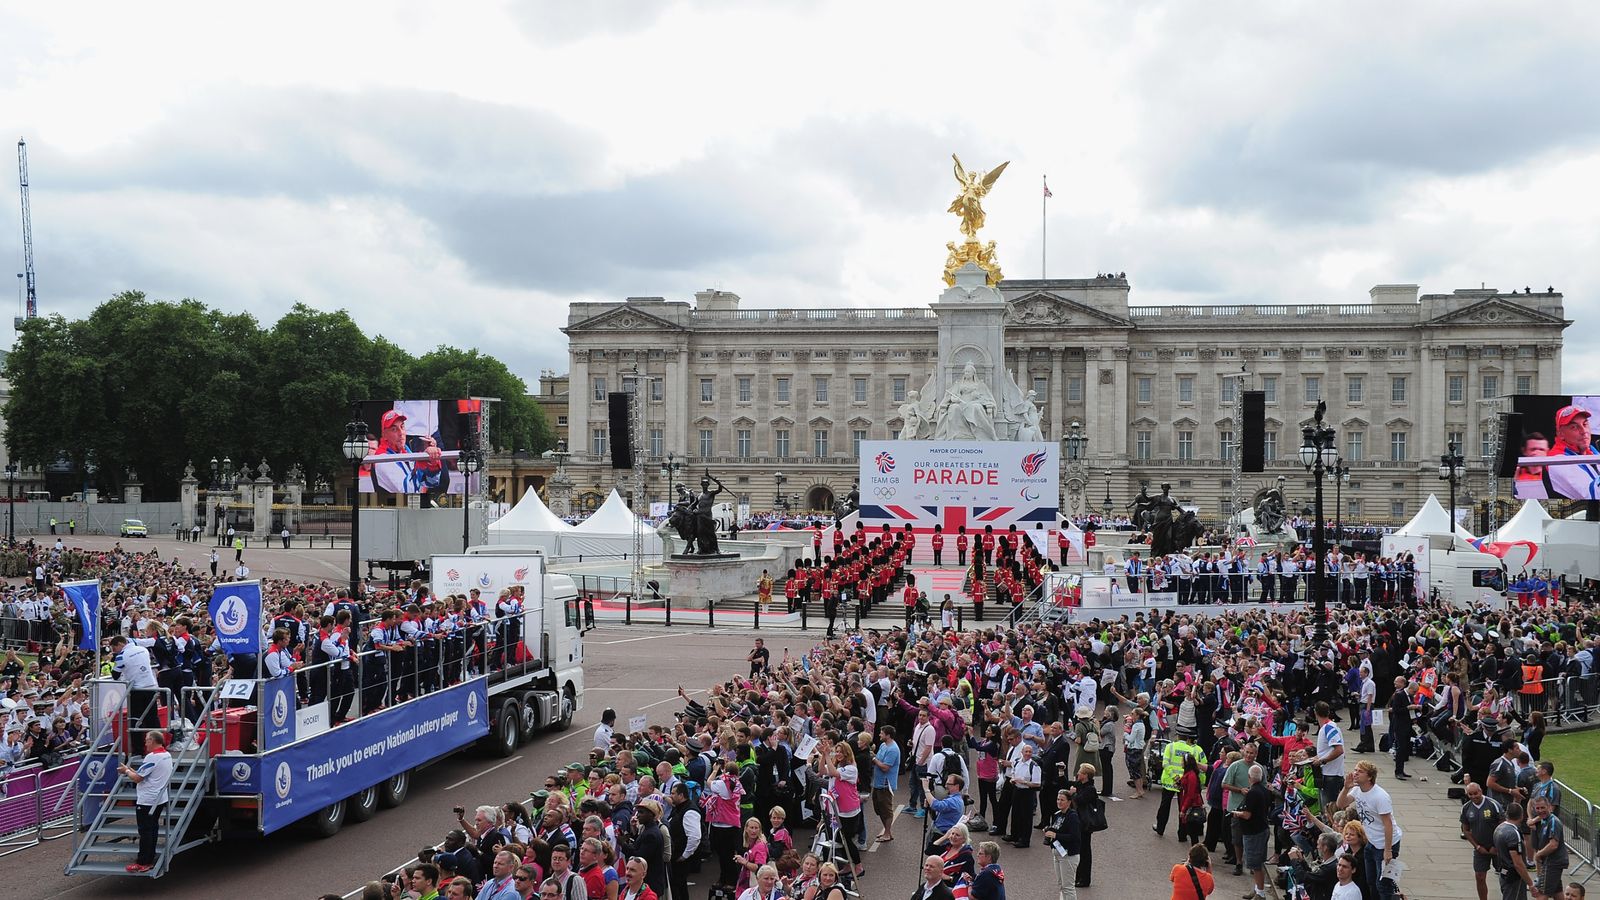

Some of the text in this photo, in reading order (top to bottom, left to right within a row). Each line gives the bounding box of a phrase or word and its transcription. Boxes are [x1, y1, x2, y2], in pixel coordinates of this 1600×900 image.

[934, 461, 974, 469] GREATEST
[871, 476, 900, 484] TEAM GB
[914, 469, 999, 485] PARADE
[227, 683, 249, 697] 12
[303, 714, 320, 727] HOCKEY
[306, 710, 459, 782] Thank you to every National Lottery player
